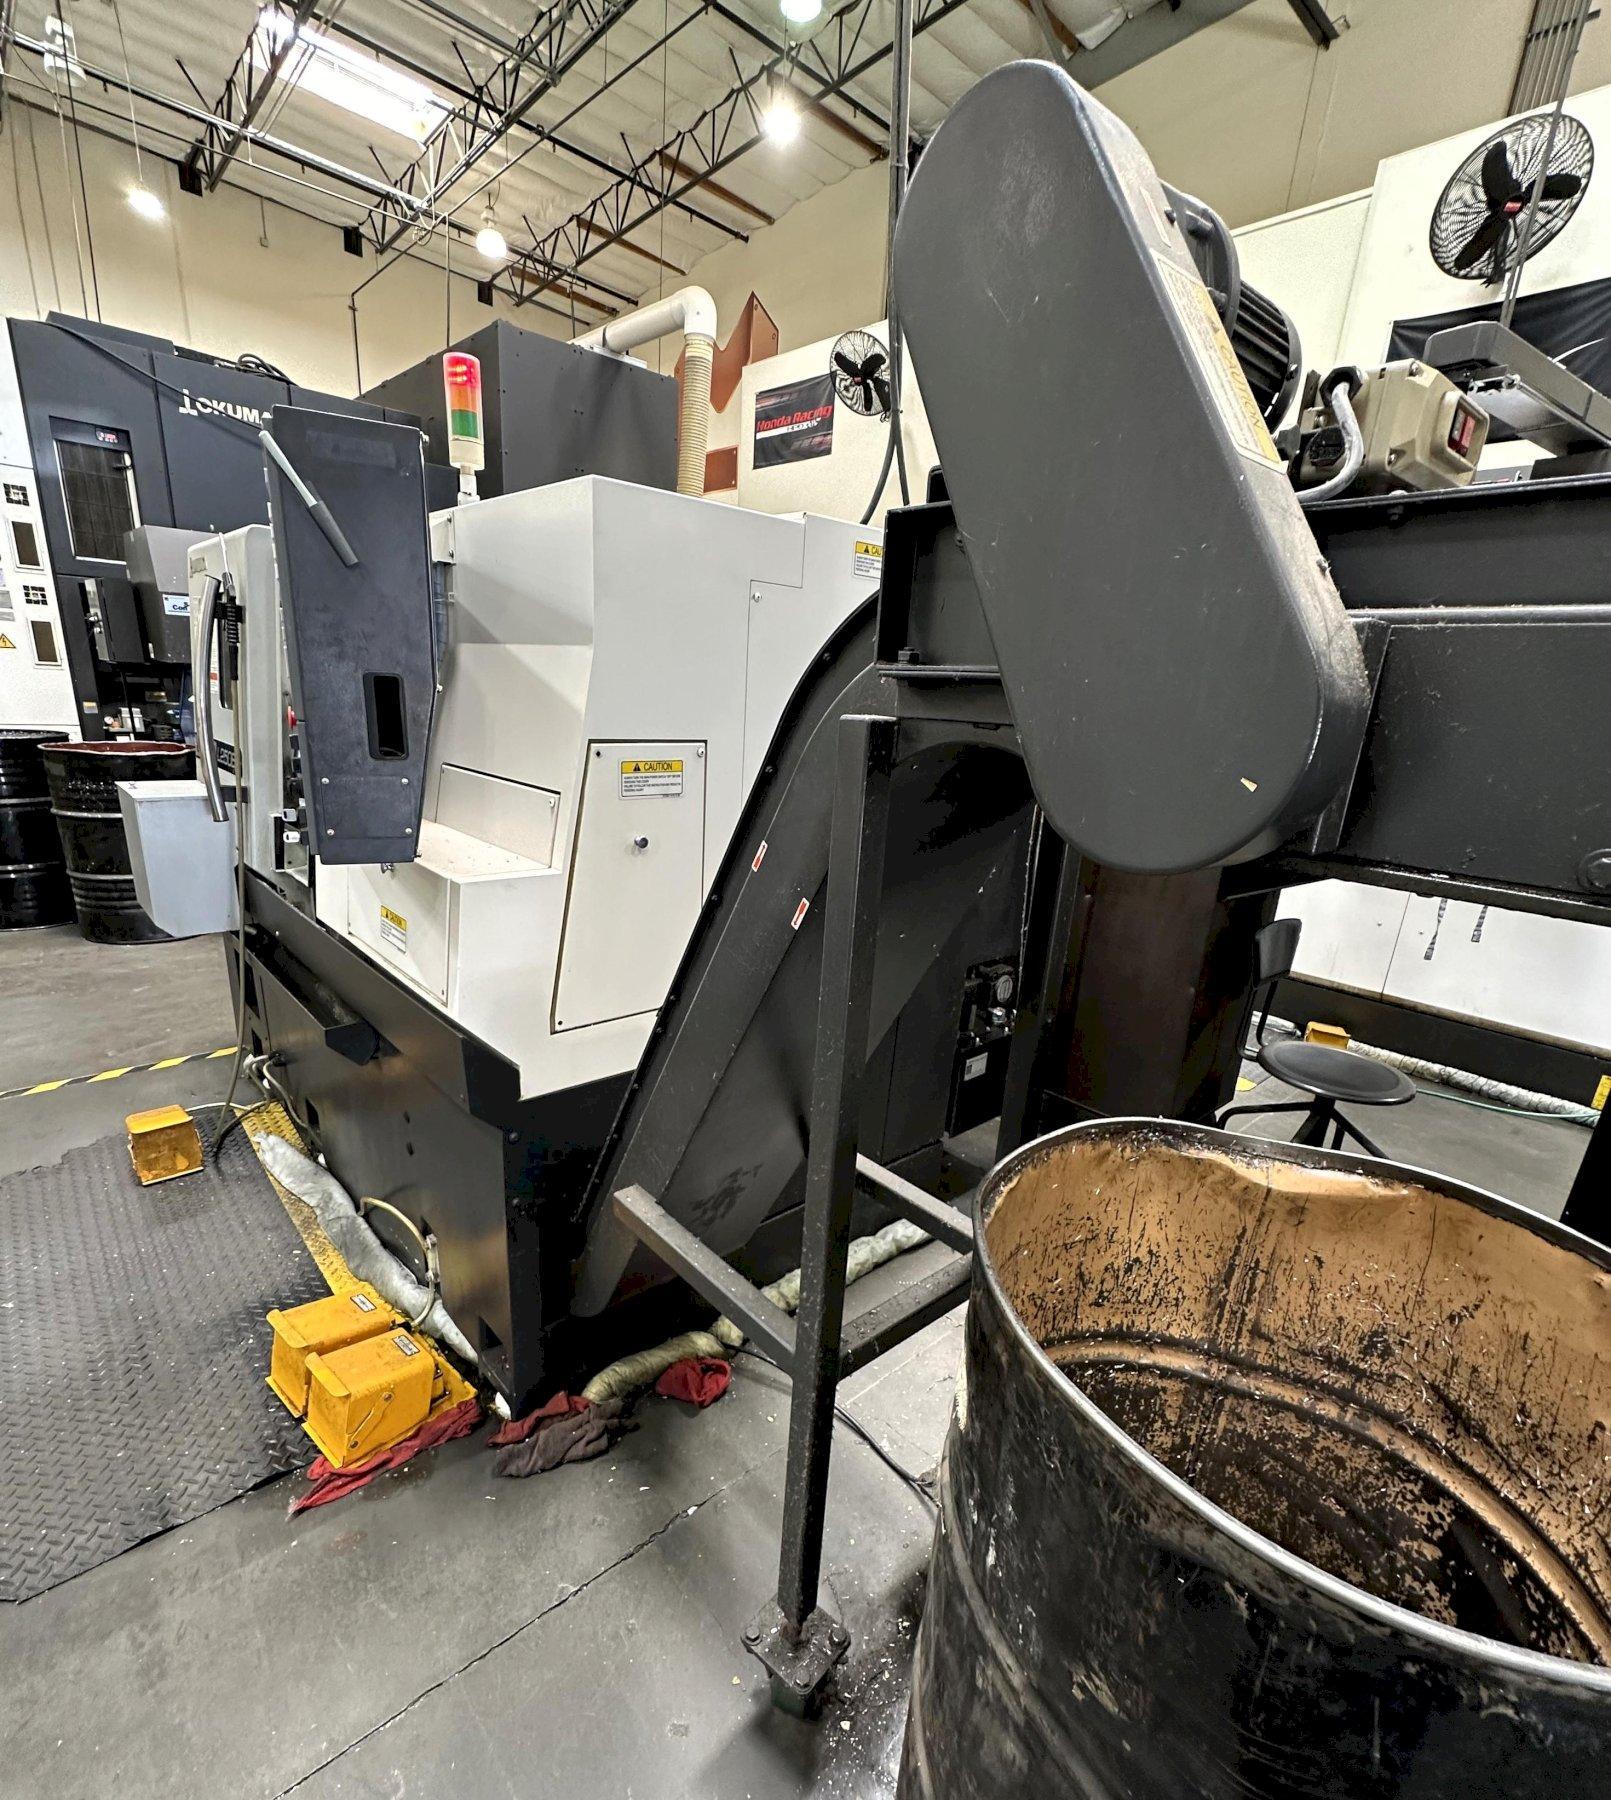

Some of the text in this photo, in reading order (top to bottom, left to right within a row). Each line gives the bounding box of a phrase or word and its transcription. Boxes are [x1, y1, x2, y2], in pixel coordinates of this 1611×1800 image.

[756, 414, 792, 432] Honda
[793, 405, 833, 424] Racing
[643, 762, 673, 771] CAUTION
